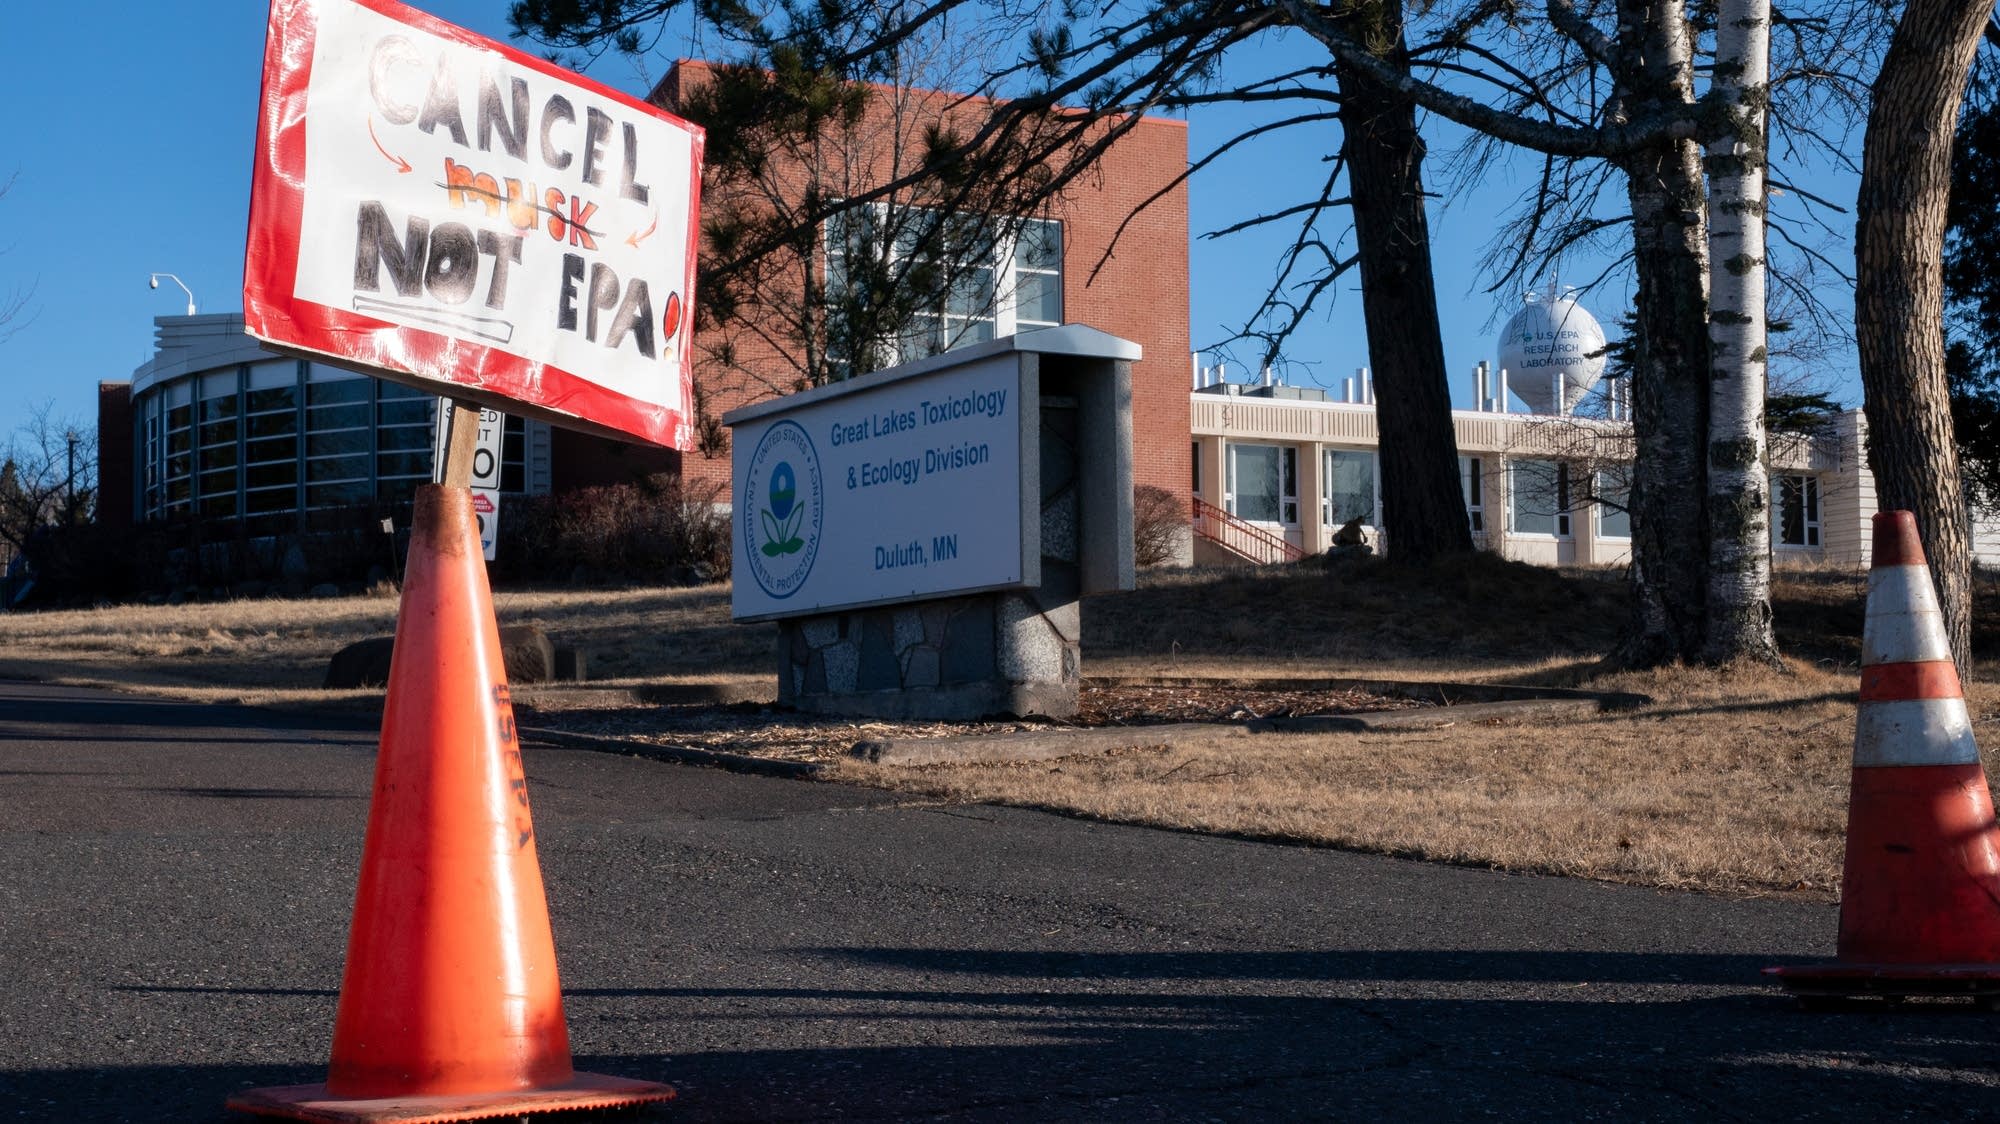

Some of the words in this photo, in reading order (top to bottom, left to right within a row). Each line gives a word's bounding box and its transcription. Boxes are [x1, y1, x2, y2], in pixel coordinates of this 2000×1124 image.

[369, 34, 650, 206] CANCEL
[353, 200, 523, 310] NOT
[557, 253, 681, 361] EPA!
[1524, 344, 1579, 354] RESEARCH
[1561, 331, 1579, 339] EPA
[1520, 357, 1584, 369] LABORATORY
[831, 418, 869, 447] Great
[873, 411, 916, 438] Lakes
[921, 389, 1007, 426] Toxicology
[758, 430, 782, 464] UNITED
[783, 429, 808, 456] STATES
[847, 467, 857, 489] &
[862, 456, 920, 488] Ecology
[926, 442, 989, 474] Division
[747, 480, 774, 589] ENVIRONMENTAL
[776, 533, 817, 590] PROTECTION
[809, 466, 820, 529] AGENCY
[875, 542, 928, 570] Duluth,
[932, 534, 957, 560] MN
